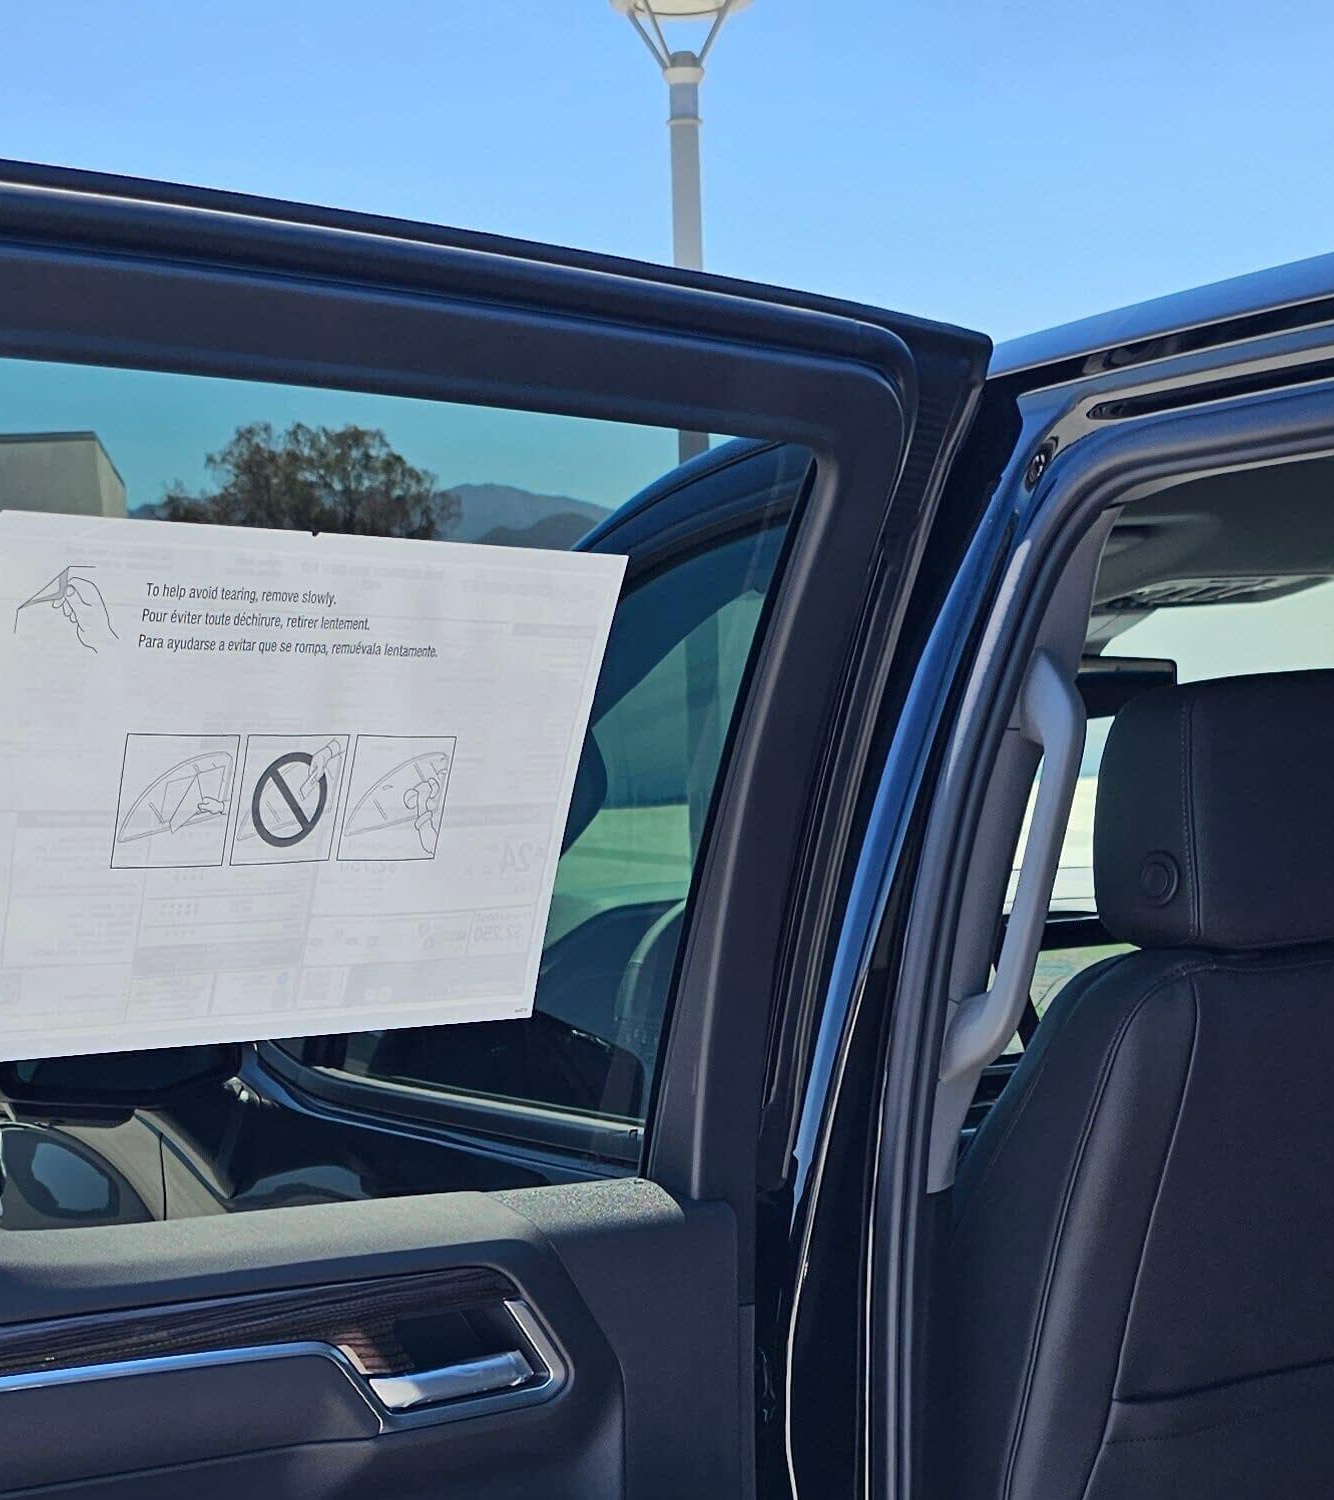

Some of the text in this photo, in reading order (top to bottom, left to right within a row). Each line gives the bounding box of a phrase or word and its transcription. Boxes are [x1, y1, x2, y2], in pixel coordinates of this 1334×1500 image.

[147, 583, 337, 607] To help avoid tearing, remove slowly.
[142, 609, 370, 631] Pour éviter toute déchirure, retirer lentement.
[139, 634, 438, 658] Para ayudarse a evitar que se rompa, remuévala lentamente.
